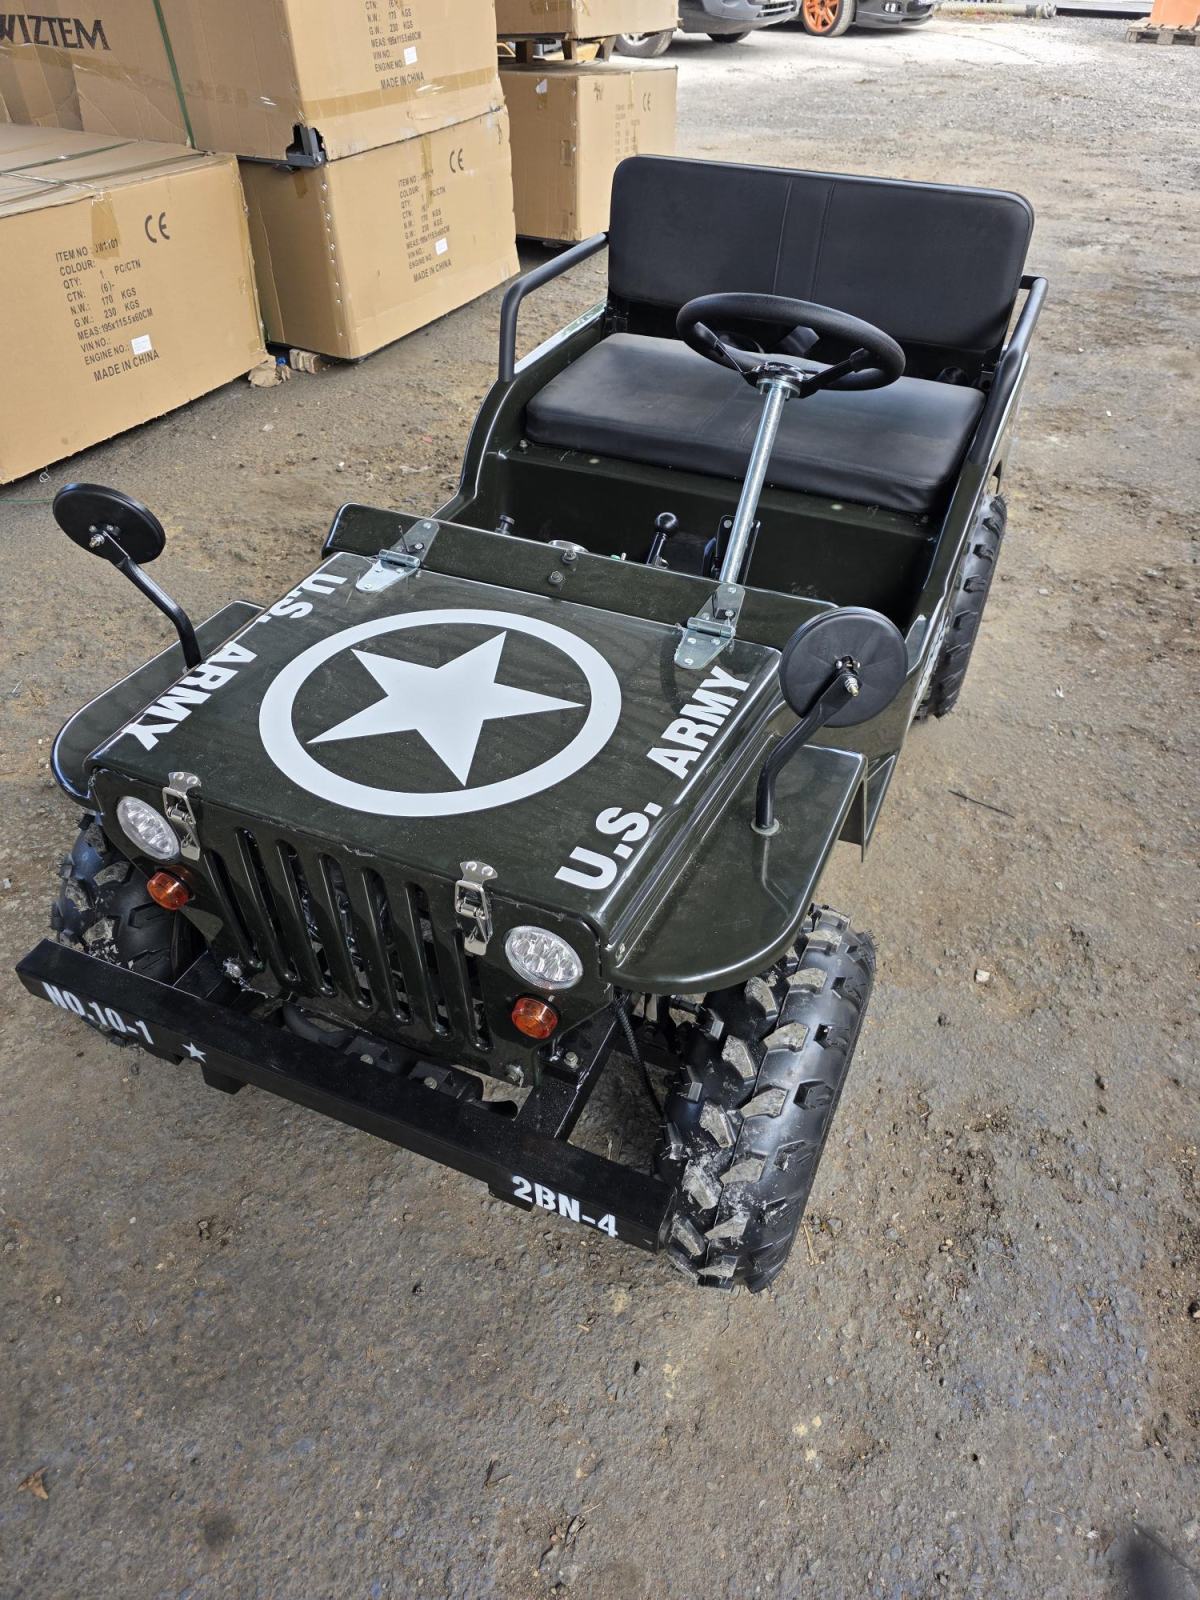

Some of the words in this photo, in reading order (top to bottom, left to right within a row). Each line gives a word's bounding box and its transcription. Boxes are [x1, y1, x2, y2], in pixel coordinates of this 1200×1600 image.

[380, 77, 400, 89] MADE
[407, 72, 425, 85] CHINA
[449, 148, 464, 173] CE
[144, 211, 170, 243] CE
[59, 259, 96, 277] COLOUR:
[63, 277, 82, 289] QTY:
[66, 290, 86, 302] CTN:
[101, 294, 114, 305] 170
[121, 287, 137, 300] KGS
[104, 307, 117, 319] 230
[125, 299, 140, 312] KGS
[81, 342, 95, 353] VIN
[84, 348, 113, 366] ENGINE
[94, 363, 121, 382] MADE
[122, 359, 132, 372] IN
[133, 349, 160, 368] CHINA
[121, 640, 258, 751] ARMY
[554, 801, 663, 890] U.S.
[646, 665, 750, 780] ARMY
[511, 1175, 618, 1238] 2BN-4
